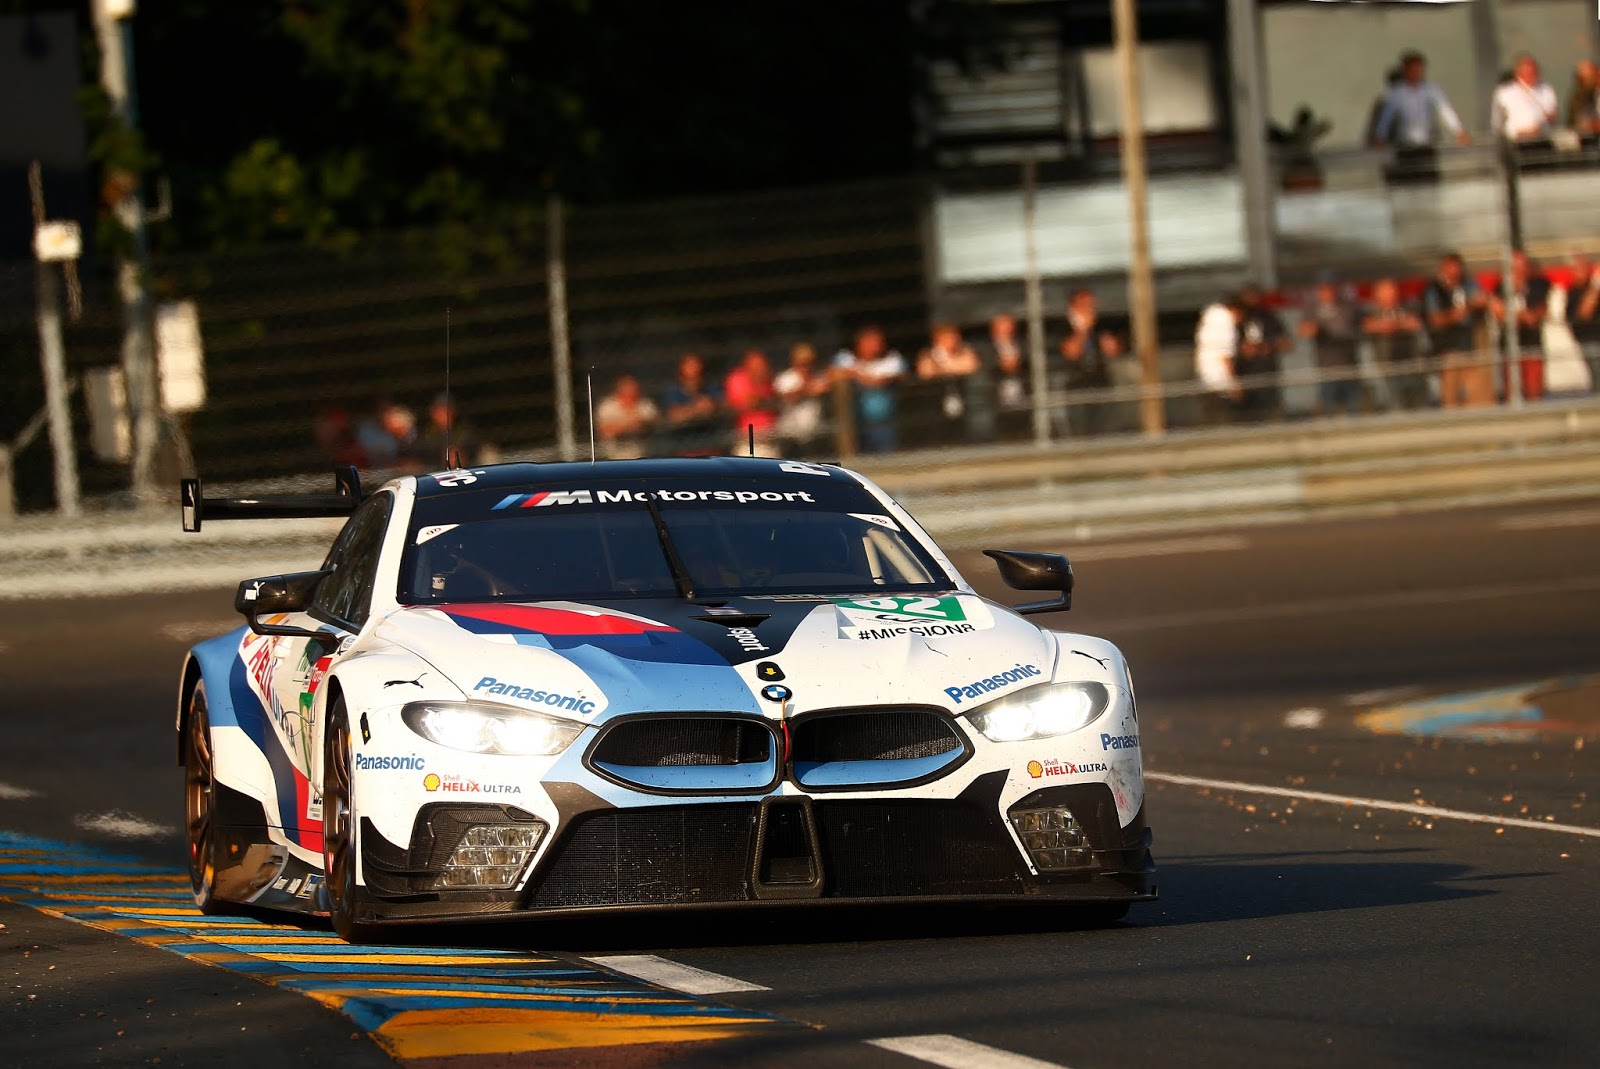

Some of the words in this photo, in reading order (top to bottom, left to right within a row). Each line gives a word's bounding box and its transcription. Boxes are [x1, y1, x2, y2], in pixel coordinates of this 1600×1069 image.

[597, 489, 816, 503] Motorsport
[943, 662, 1042, 704] Panasonic
[472, 676, 596, 715] Panasonic
[356, 752, 425, 771] Panasonic
[1043, 758, 1059, 767] Shell
[1045, 763, 1079, 777] HELIX
[1078, 762, 1108, 773] ULTRA
[443, 774, 461, 782] Shell
[442, 782, 480, 793] HELIX
[483, 784, 522, 794] ULTRA
